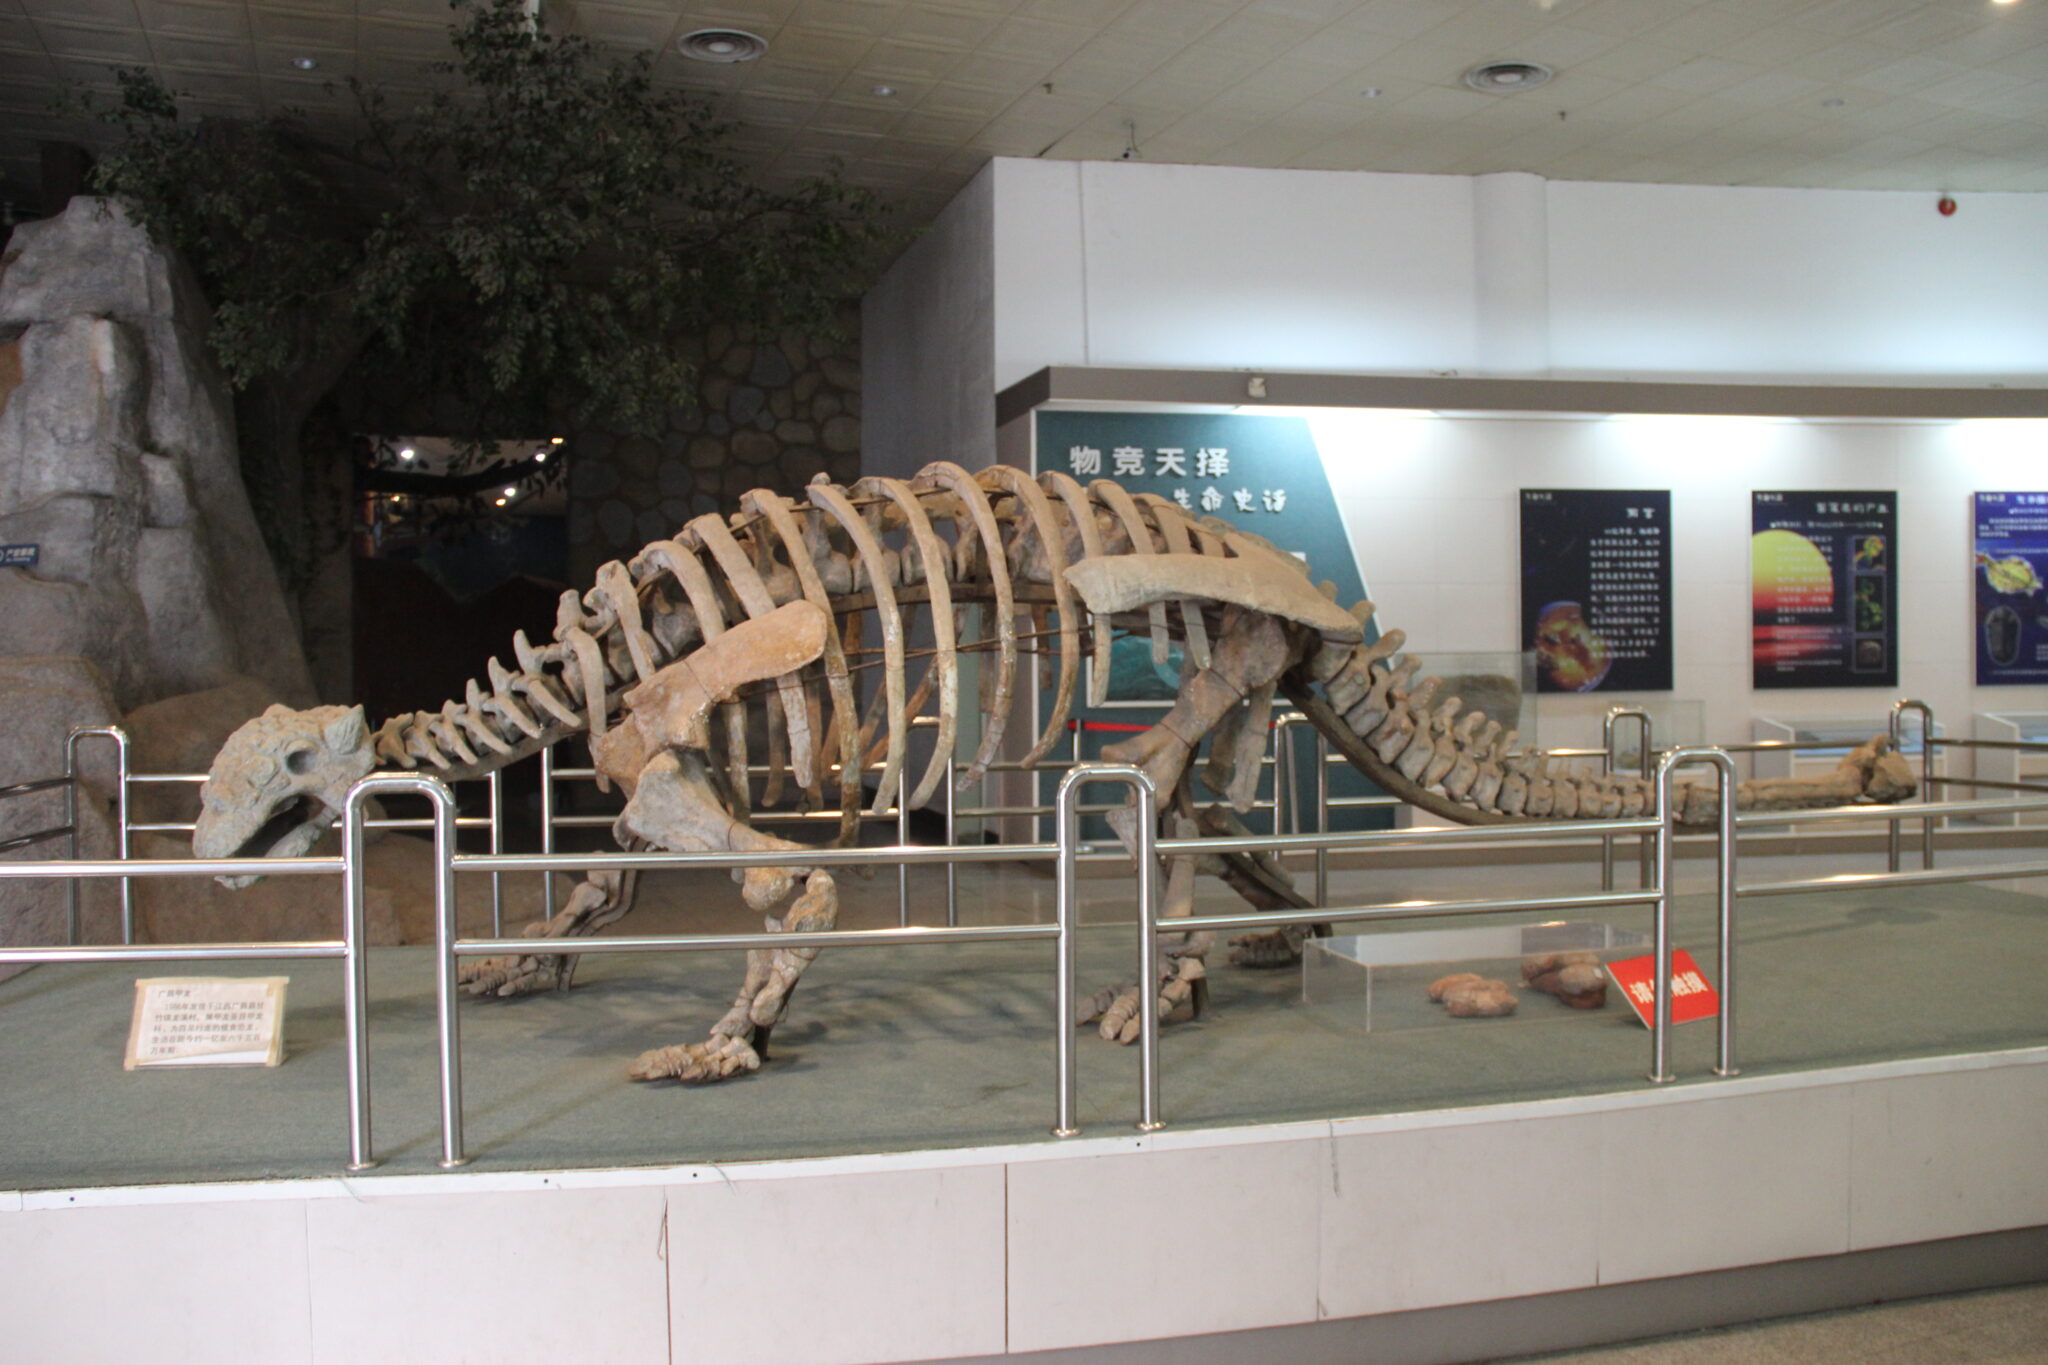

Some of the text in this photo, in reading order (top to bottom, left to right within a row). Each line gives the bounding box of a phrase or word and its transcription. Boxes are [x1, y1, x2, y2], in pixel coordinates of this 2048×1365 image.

[1069, 445, 1230, 477] 物竞天择
[1173, 485, 1288, 513] 生命史话
[1629, 971, 1708, 1004] 请触摸
